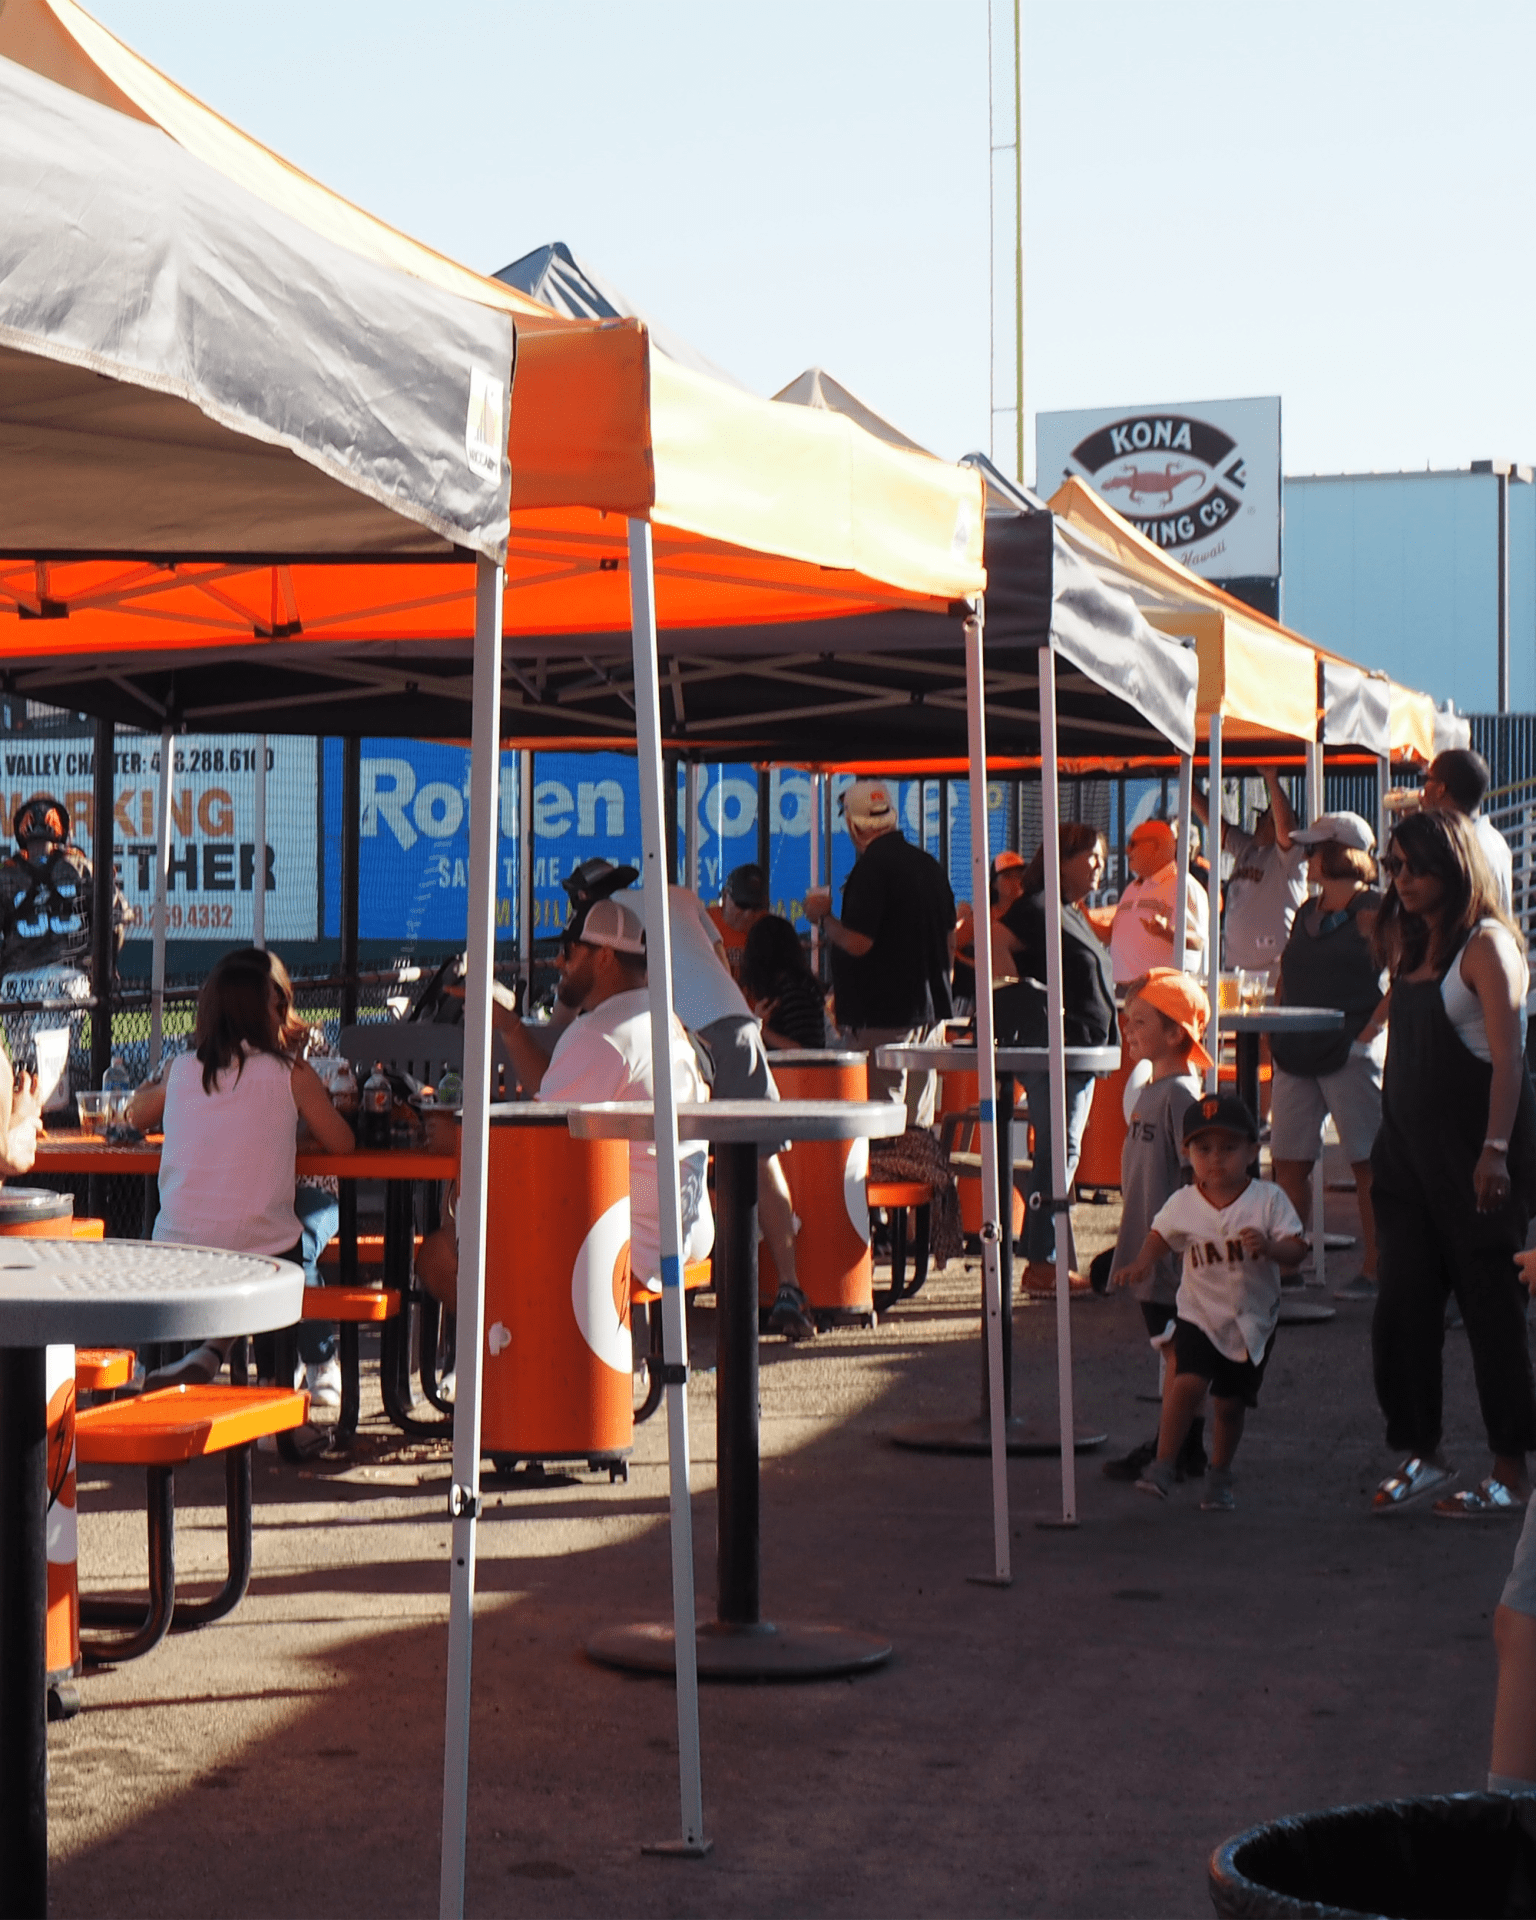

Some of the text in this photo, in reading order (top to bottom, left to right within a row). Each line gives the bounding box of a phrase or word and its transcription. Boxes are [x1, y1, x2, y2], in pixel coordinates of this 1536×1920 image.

[1110, 420, 1193, 455] KONA
[5, 747, 275, 778] VALLEY CHATER: 48.288.610
[0, 786, 235, 839] WRKING
[359, 756, 959, 851] Roten Robe
[113, 844, 277, 892] THER
[502, 856, 561, 888] TME
